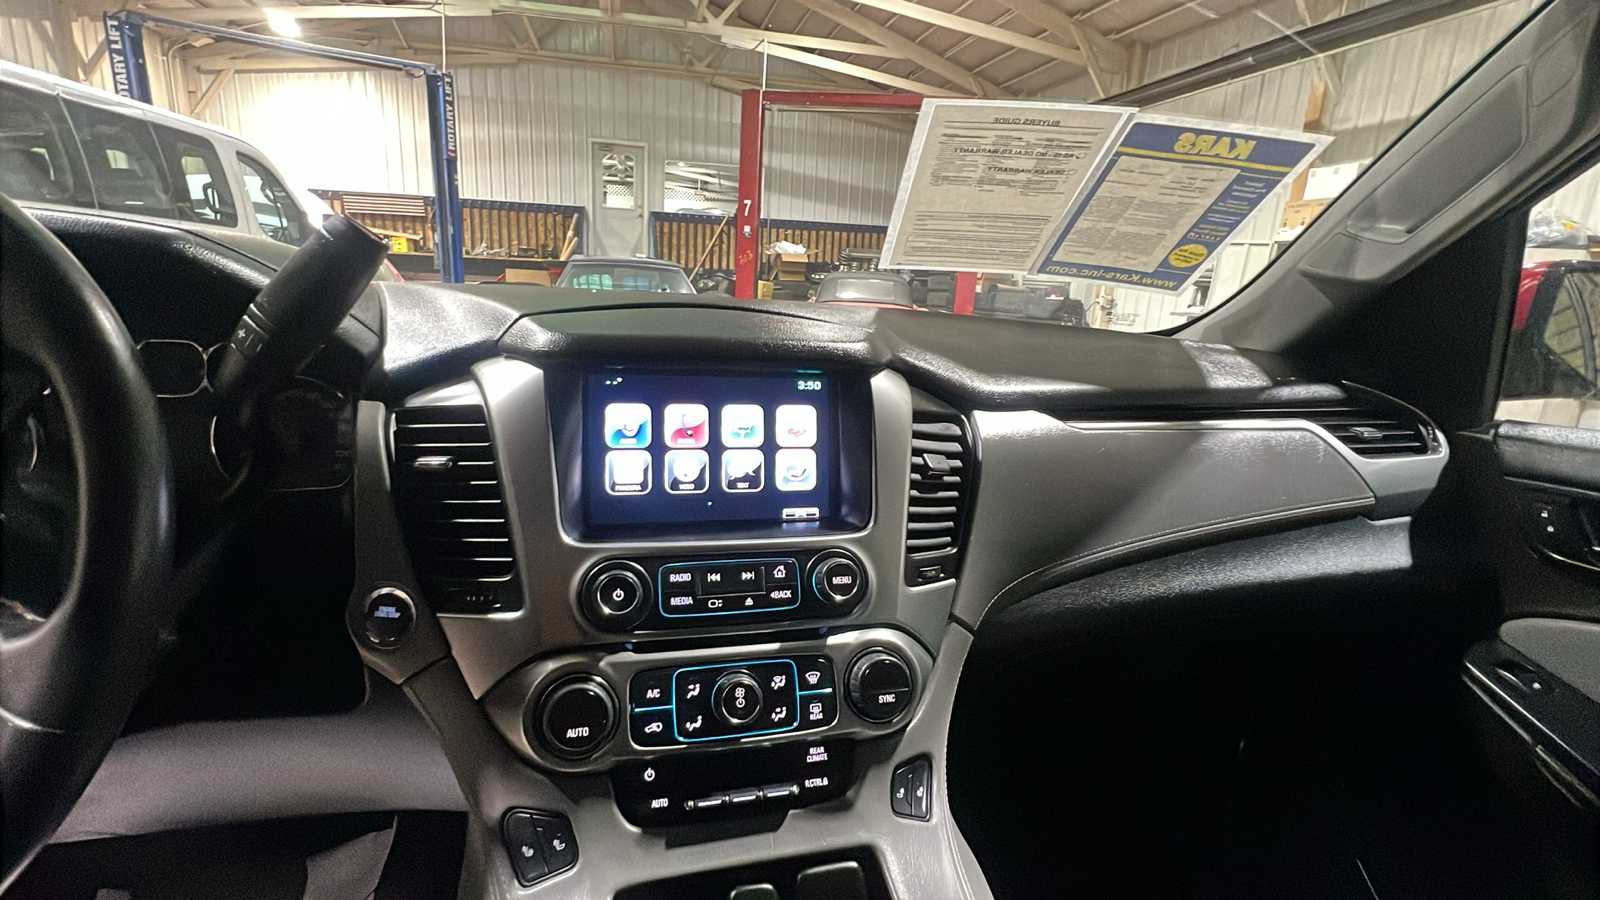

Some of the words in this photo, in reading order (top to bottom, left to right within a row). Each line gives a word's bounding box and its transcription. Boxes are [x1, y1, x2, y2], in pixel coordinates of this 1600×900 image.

[106, 18, 123, 49] LIFT
[112, 53, 131, 98] OTARY
[444, 75, 454, 100] LIFT
[446, 103, 456, 150] ROTARY
[743, 199, 752, 216] 7
[797, 381, 822, 390] 3:50
[670, 573, 691, 582] RADIO
[832, 576, 852, 584] MENU
[670, 596, 693, 605] MEDIA
[646, 689, 661, 699] A/C
[878, 694, 896, 704] SYNC
[566, 727, 589, 738] AUTO
[810, 746, 825, 754] REAR
[807, 753, 828, 762] CLIMATE
[651, 798, 669, 808] AUTO
